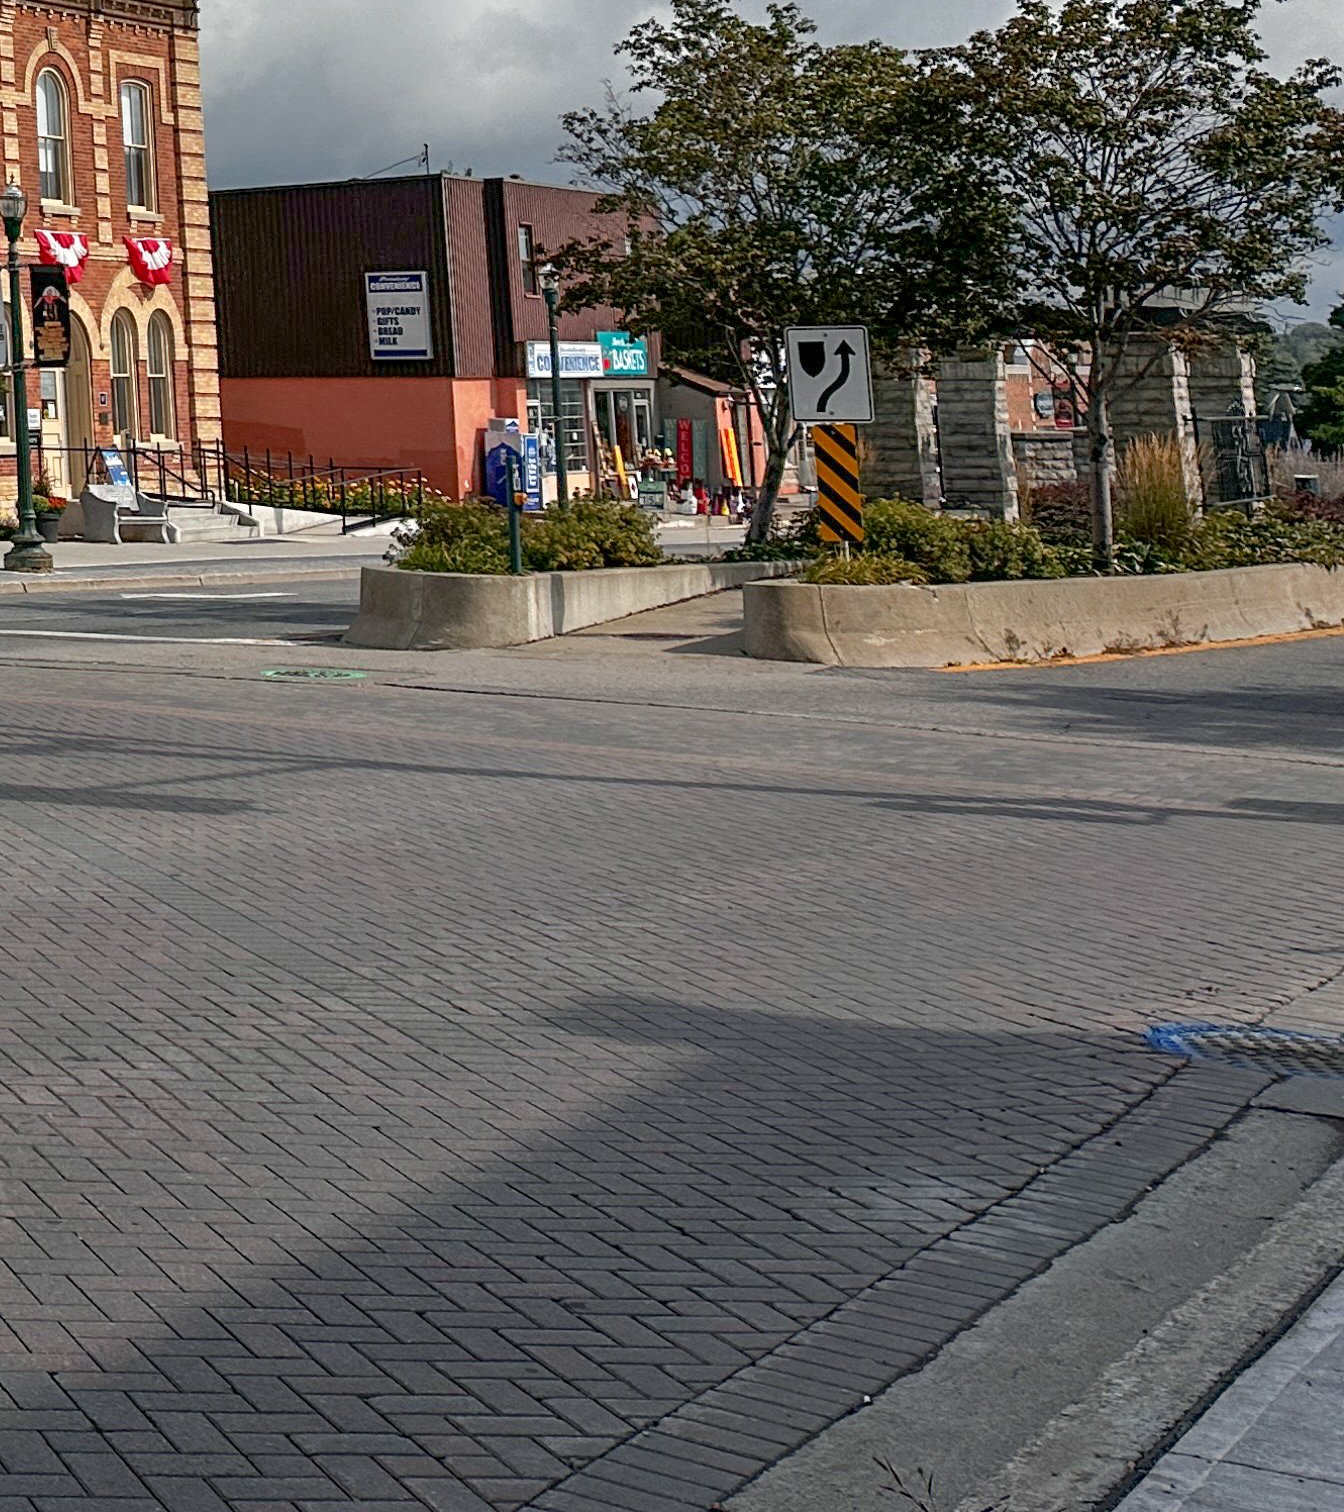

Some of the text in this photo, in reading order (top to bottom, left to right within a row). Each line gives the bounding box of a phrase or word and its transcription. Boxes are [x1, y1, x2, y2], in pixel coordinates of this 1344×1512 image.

[377, 317, 399, 326] GIFTS
[378, 327, 403, 336] BREAD
[379, 337, 398, 346] MILK
[612, 349, 645, 370] BASKETS
